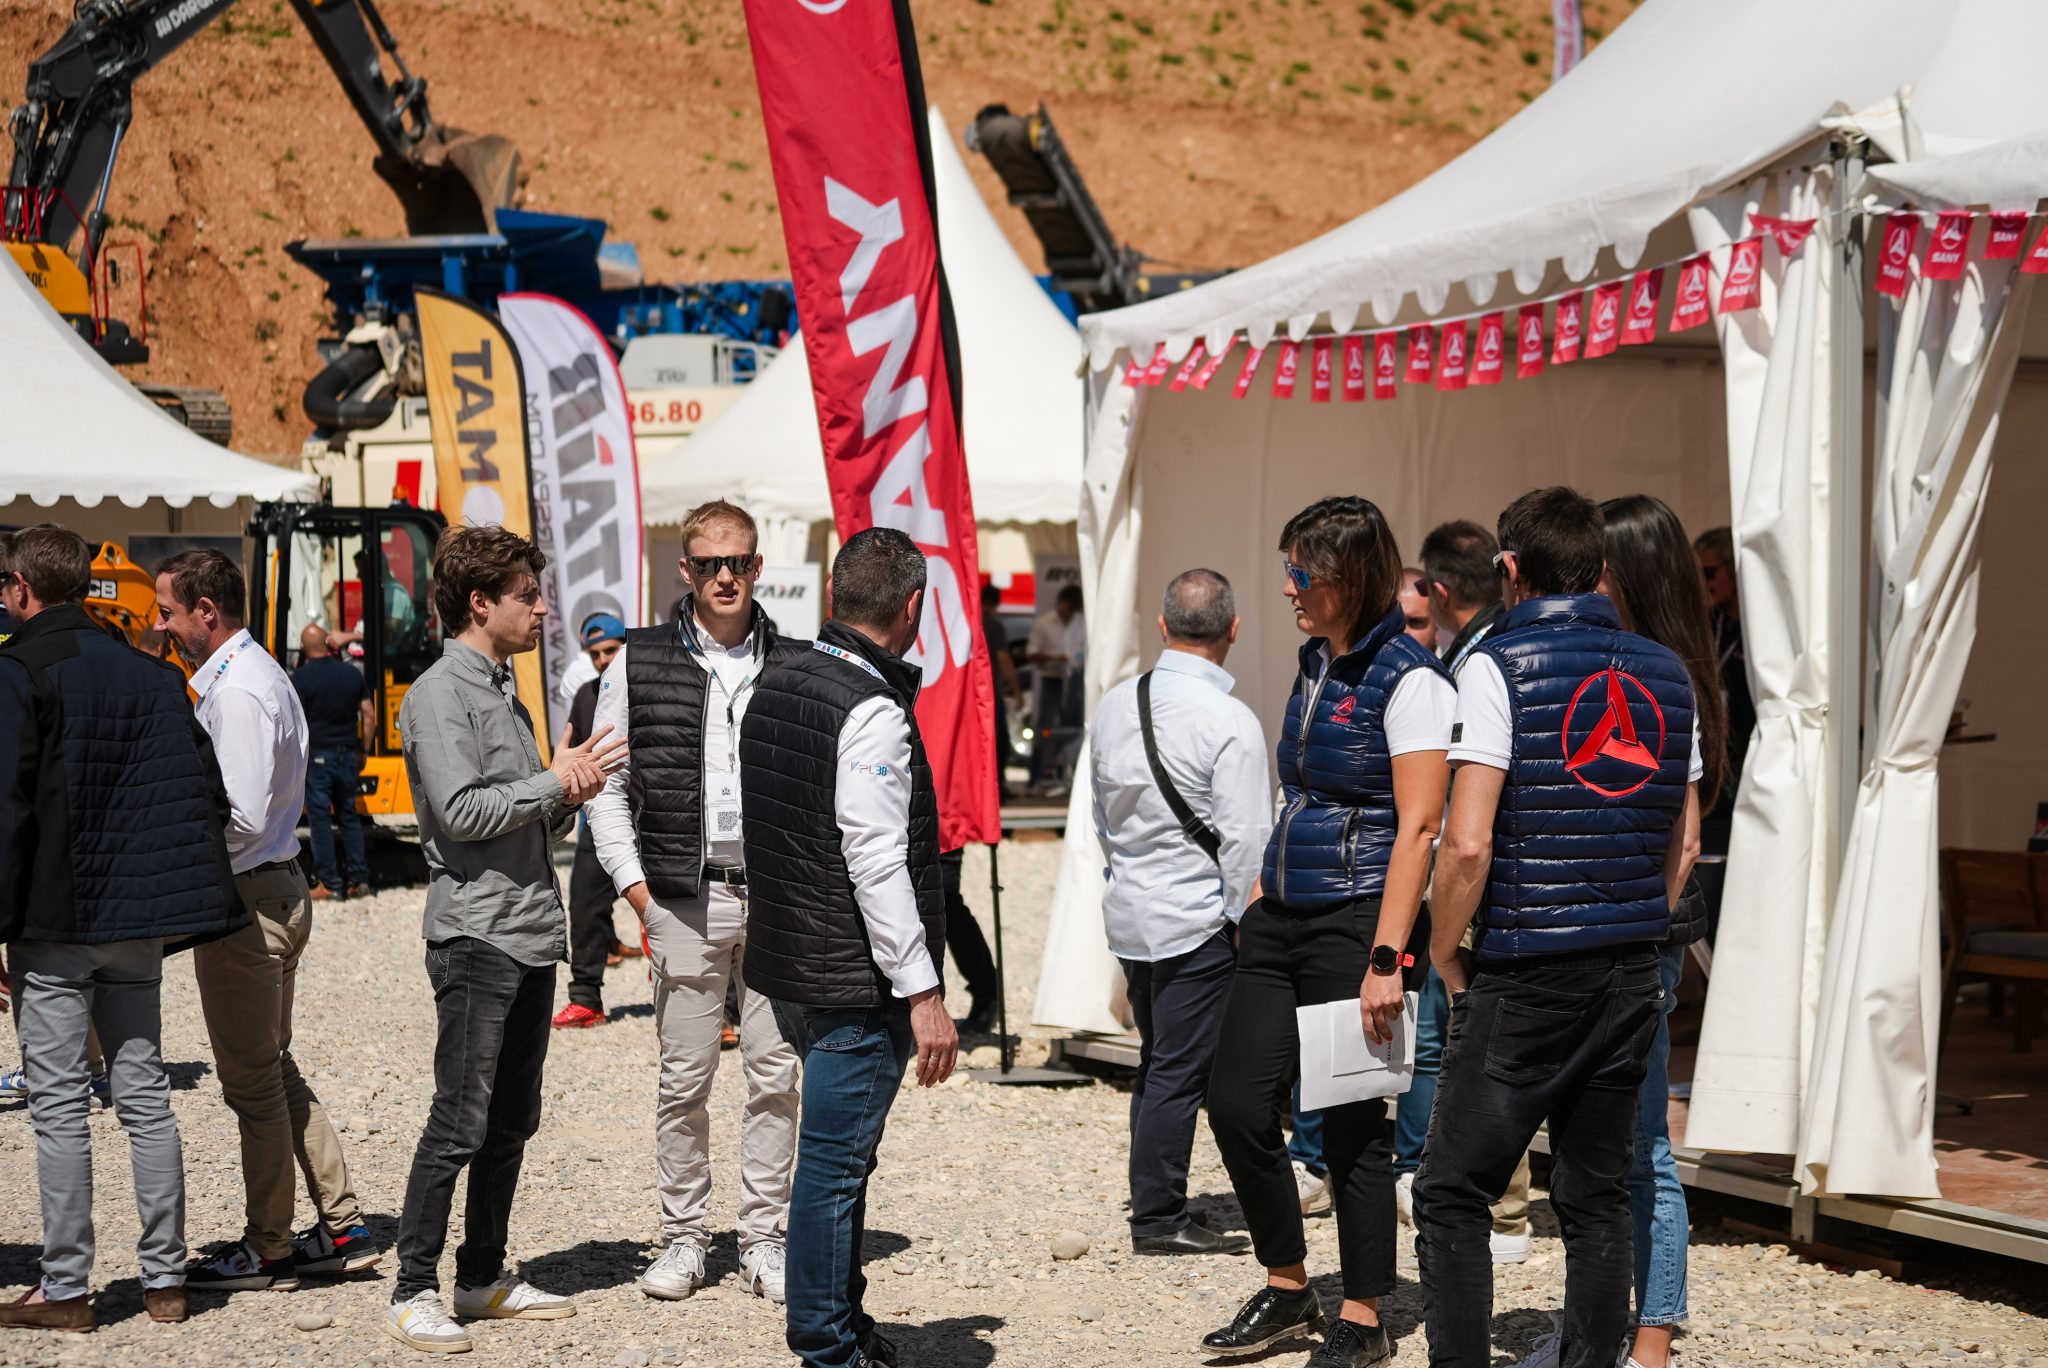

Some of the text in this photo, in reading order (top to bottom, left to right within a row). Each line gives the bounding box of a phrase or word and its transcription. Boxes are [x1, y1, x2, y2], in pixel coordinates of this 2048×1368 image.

[1931, 251, 1961, 264] SANY
[824, 176, 972, 690] SANY
[88, 580, 117, 599] CB
